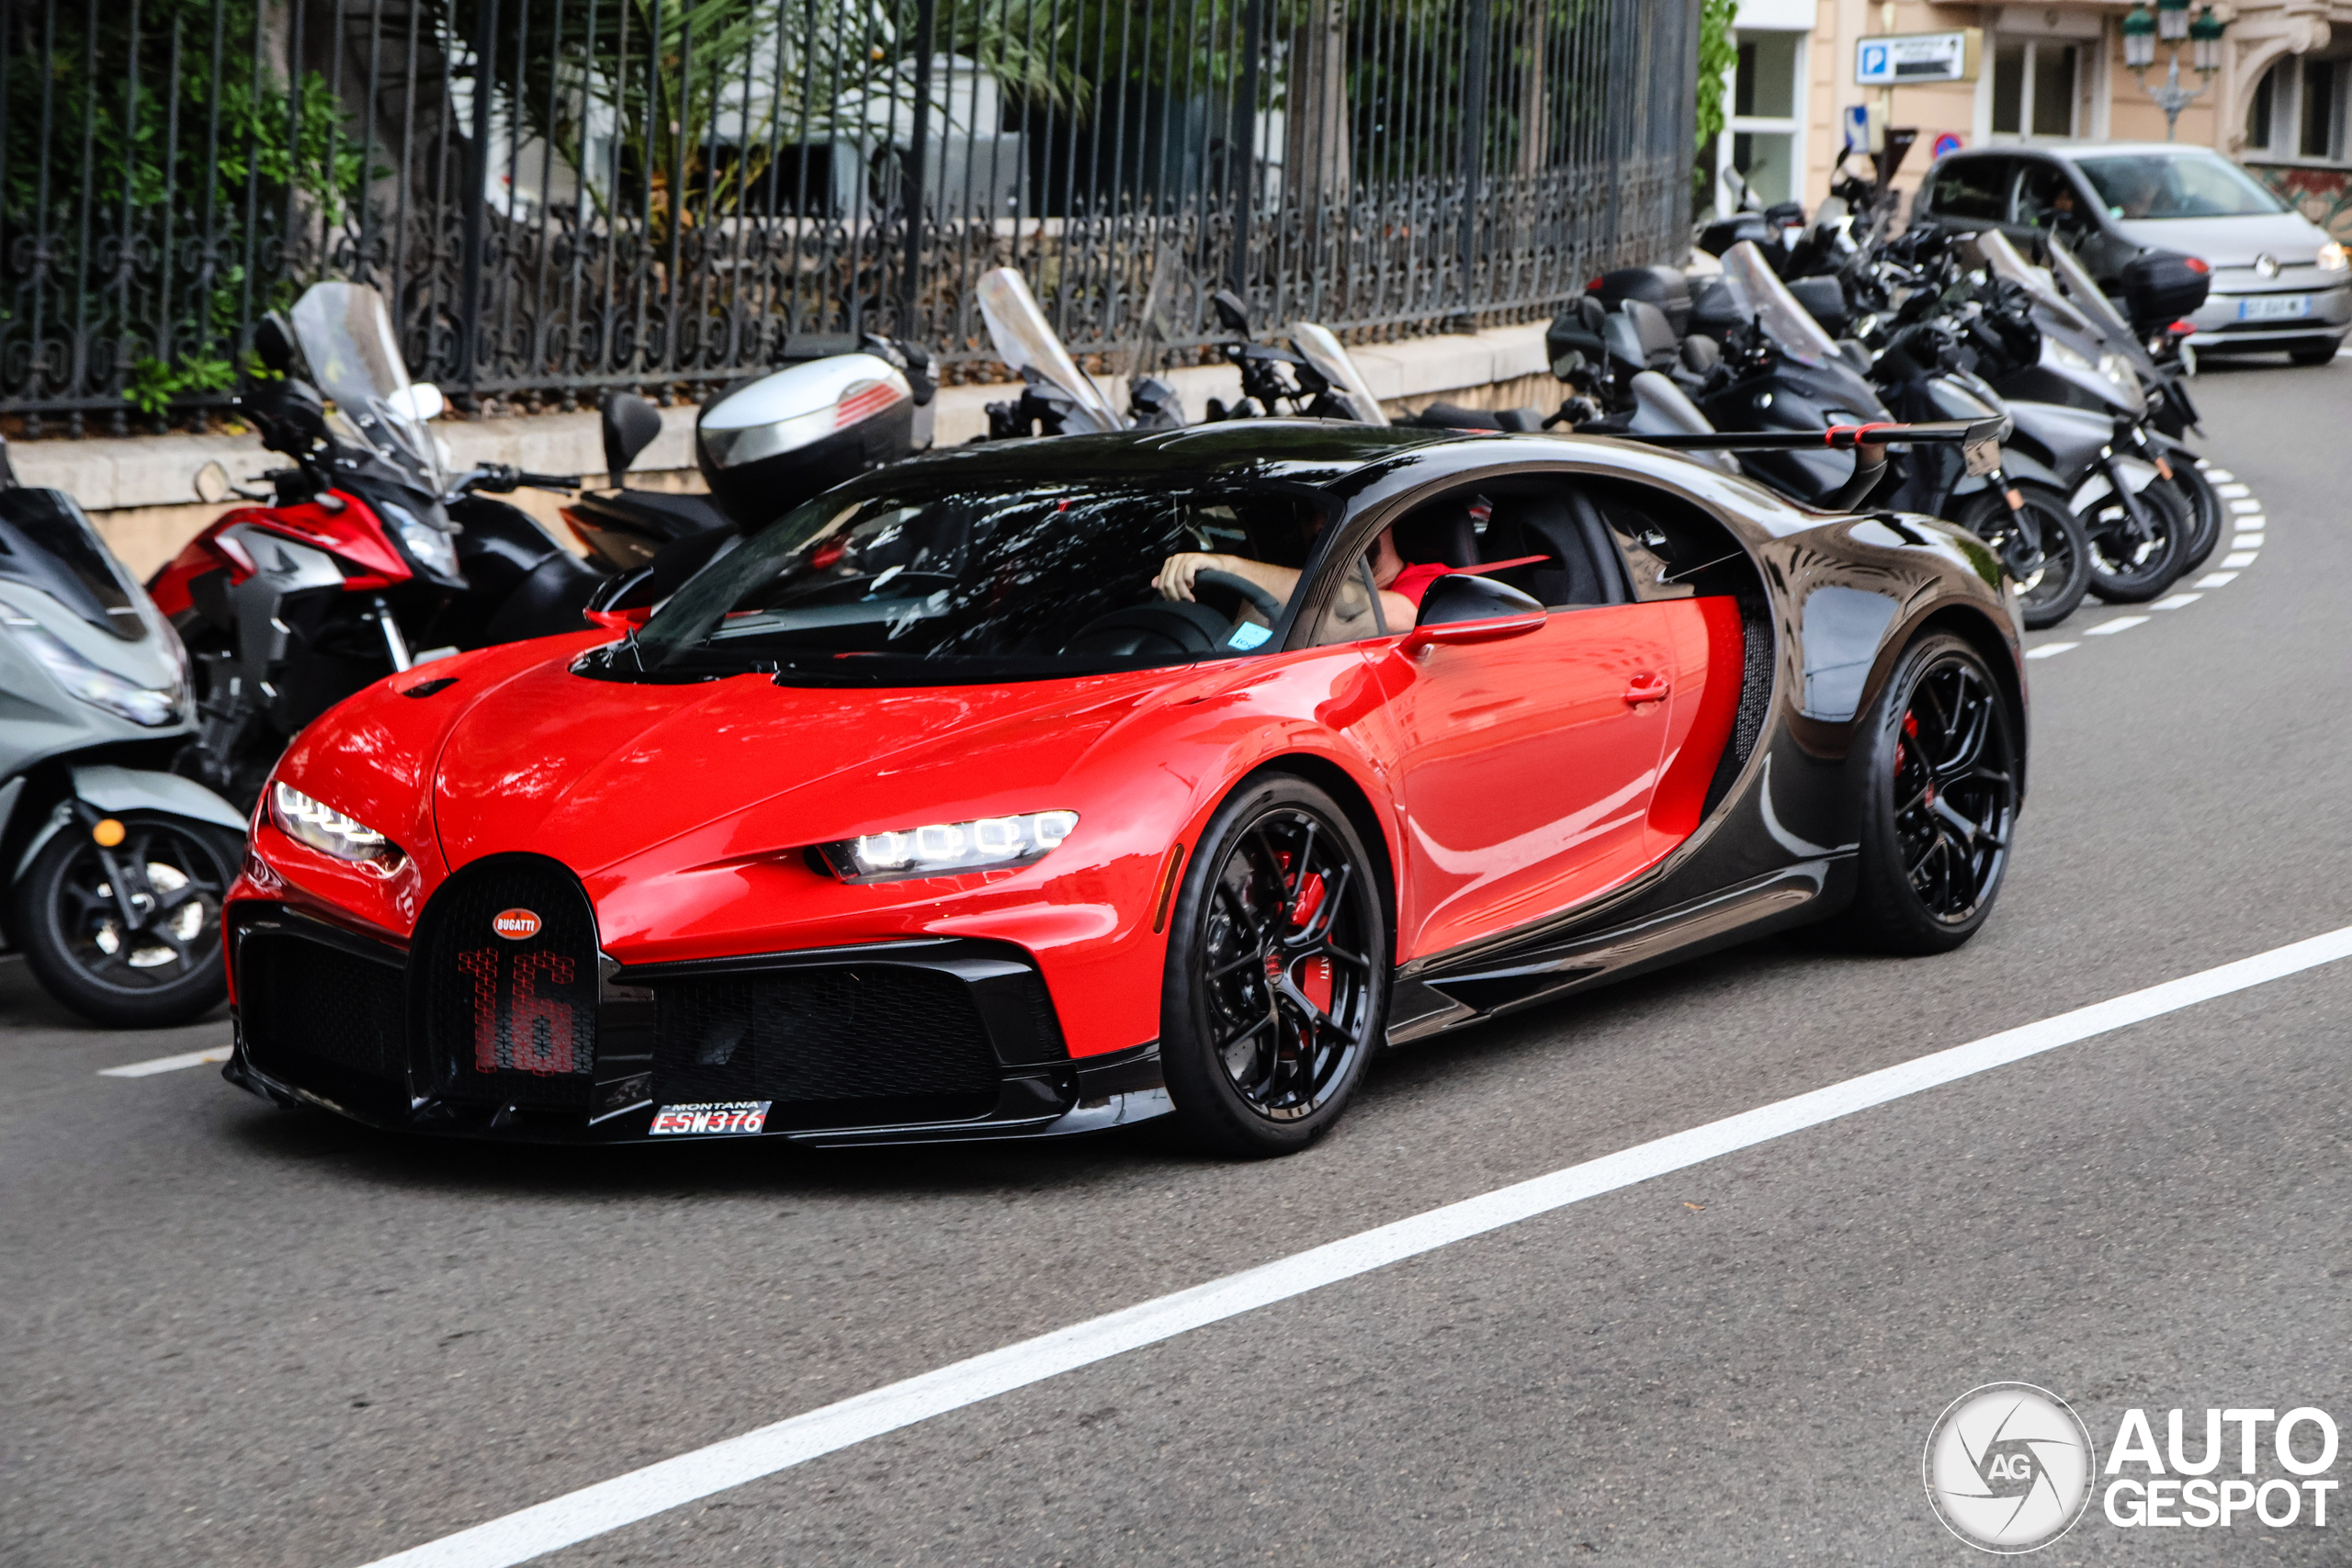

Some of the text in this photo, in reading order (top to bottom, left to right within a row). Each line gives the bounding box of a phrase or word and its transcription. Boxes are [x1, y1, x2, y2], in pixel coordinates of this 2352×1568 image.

[497, 918, 535, 931] BUGATTI
[1320, 956, 1329, 979] ATTI
[458, 947, 575, 1077] 16
[672, 1100, 759, 1111] MONTANA
[653, 1109, 763, 1134] ESW376
